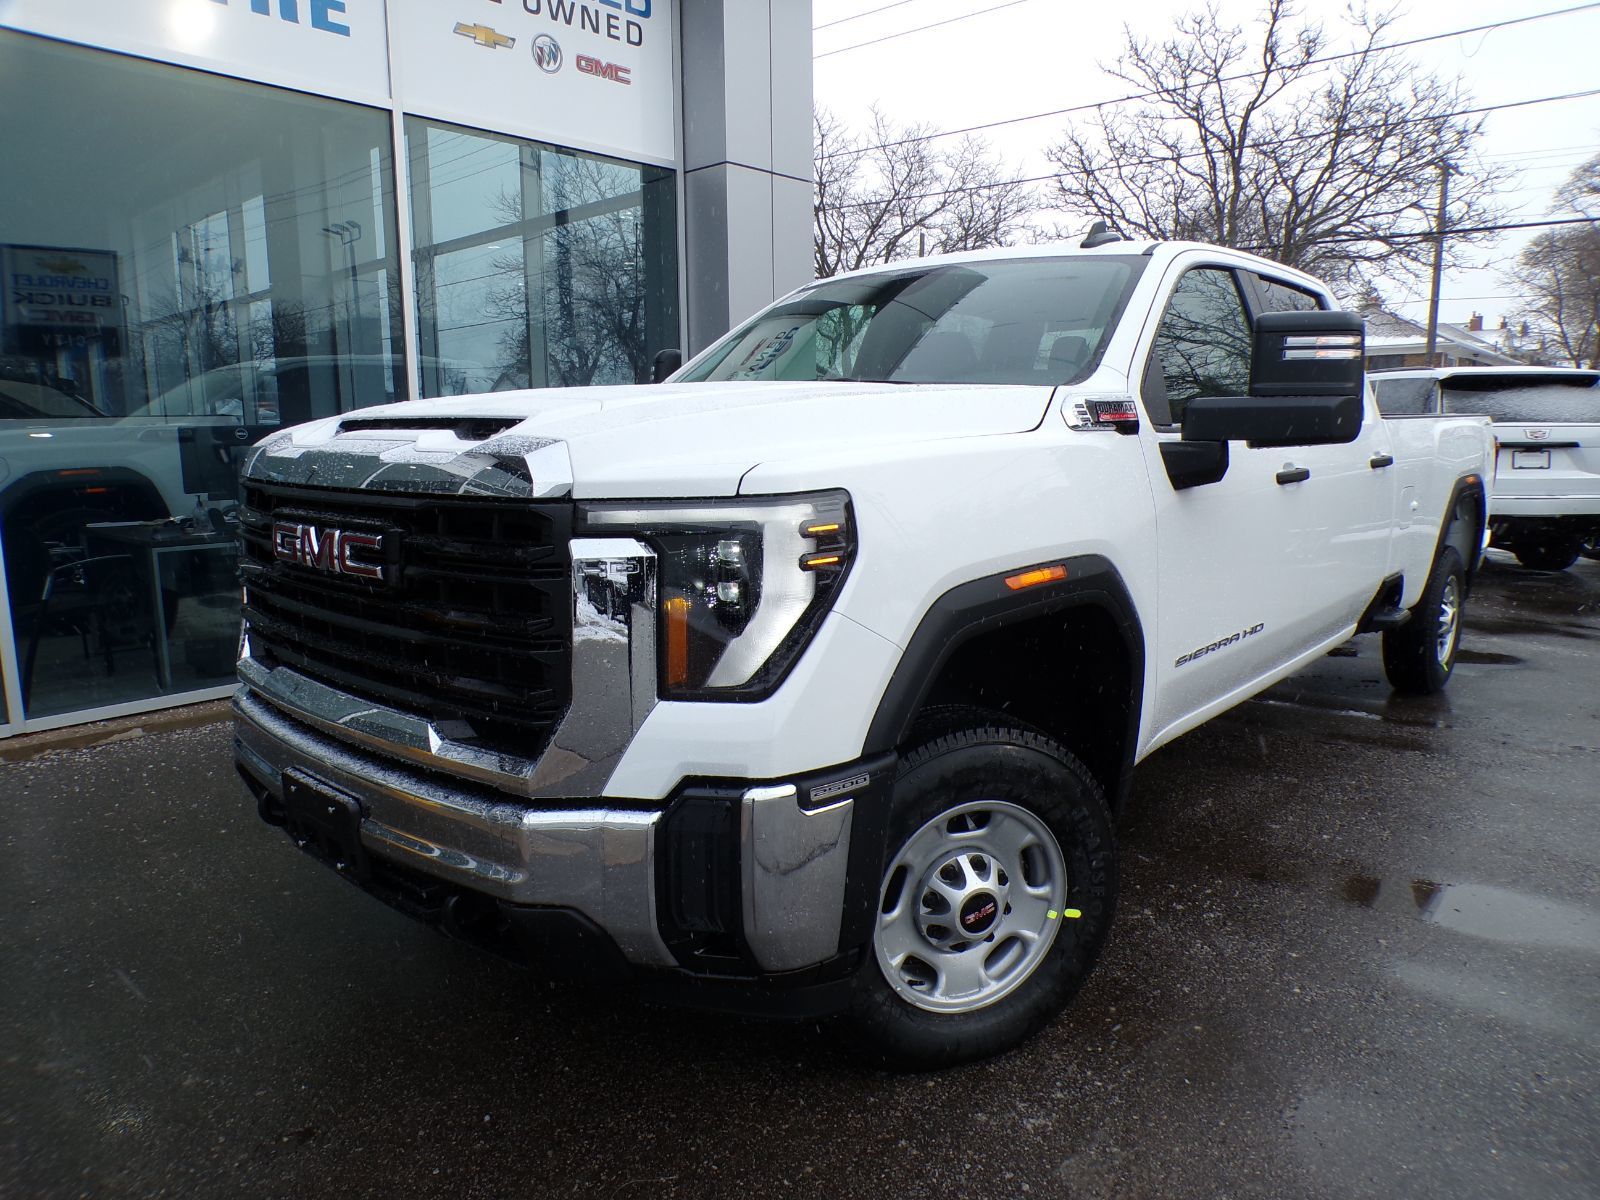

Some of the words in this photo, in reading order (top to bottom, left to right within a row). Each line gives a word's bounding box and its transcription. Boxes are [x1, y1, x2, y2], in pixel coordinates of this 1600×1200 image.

[575, 53, 631, 85] GMC
[1096, 401, 1135, 414] DURAMAX
[273, 521, 384, 580] GMC
[1175, 632, 1240, 668] SIERRA
[1242, 622, 1264, 639] HD
[812, 775, 868, 798] 2500
[965, 902, 995, 924] GMC
